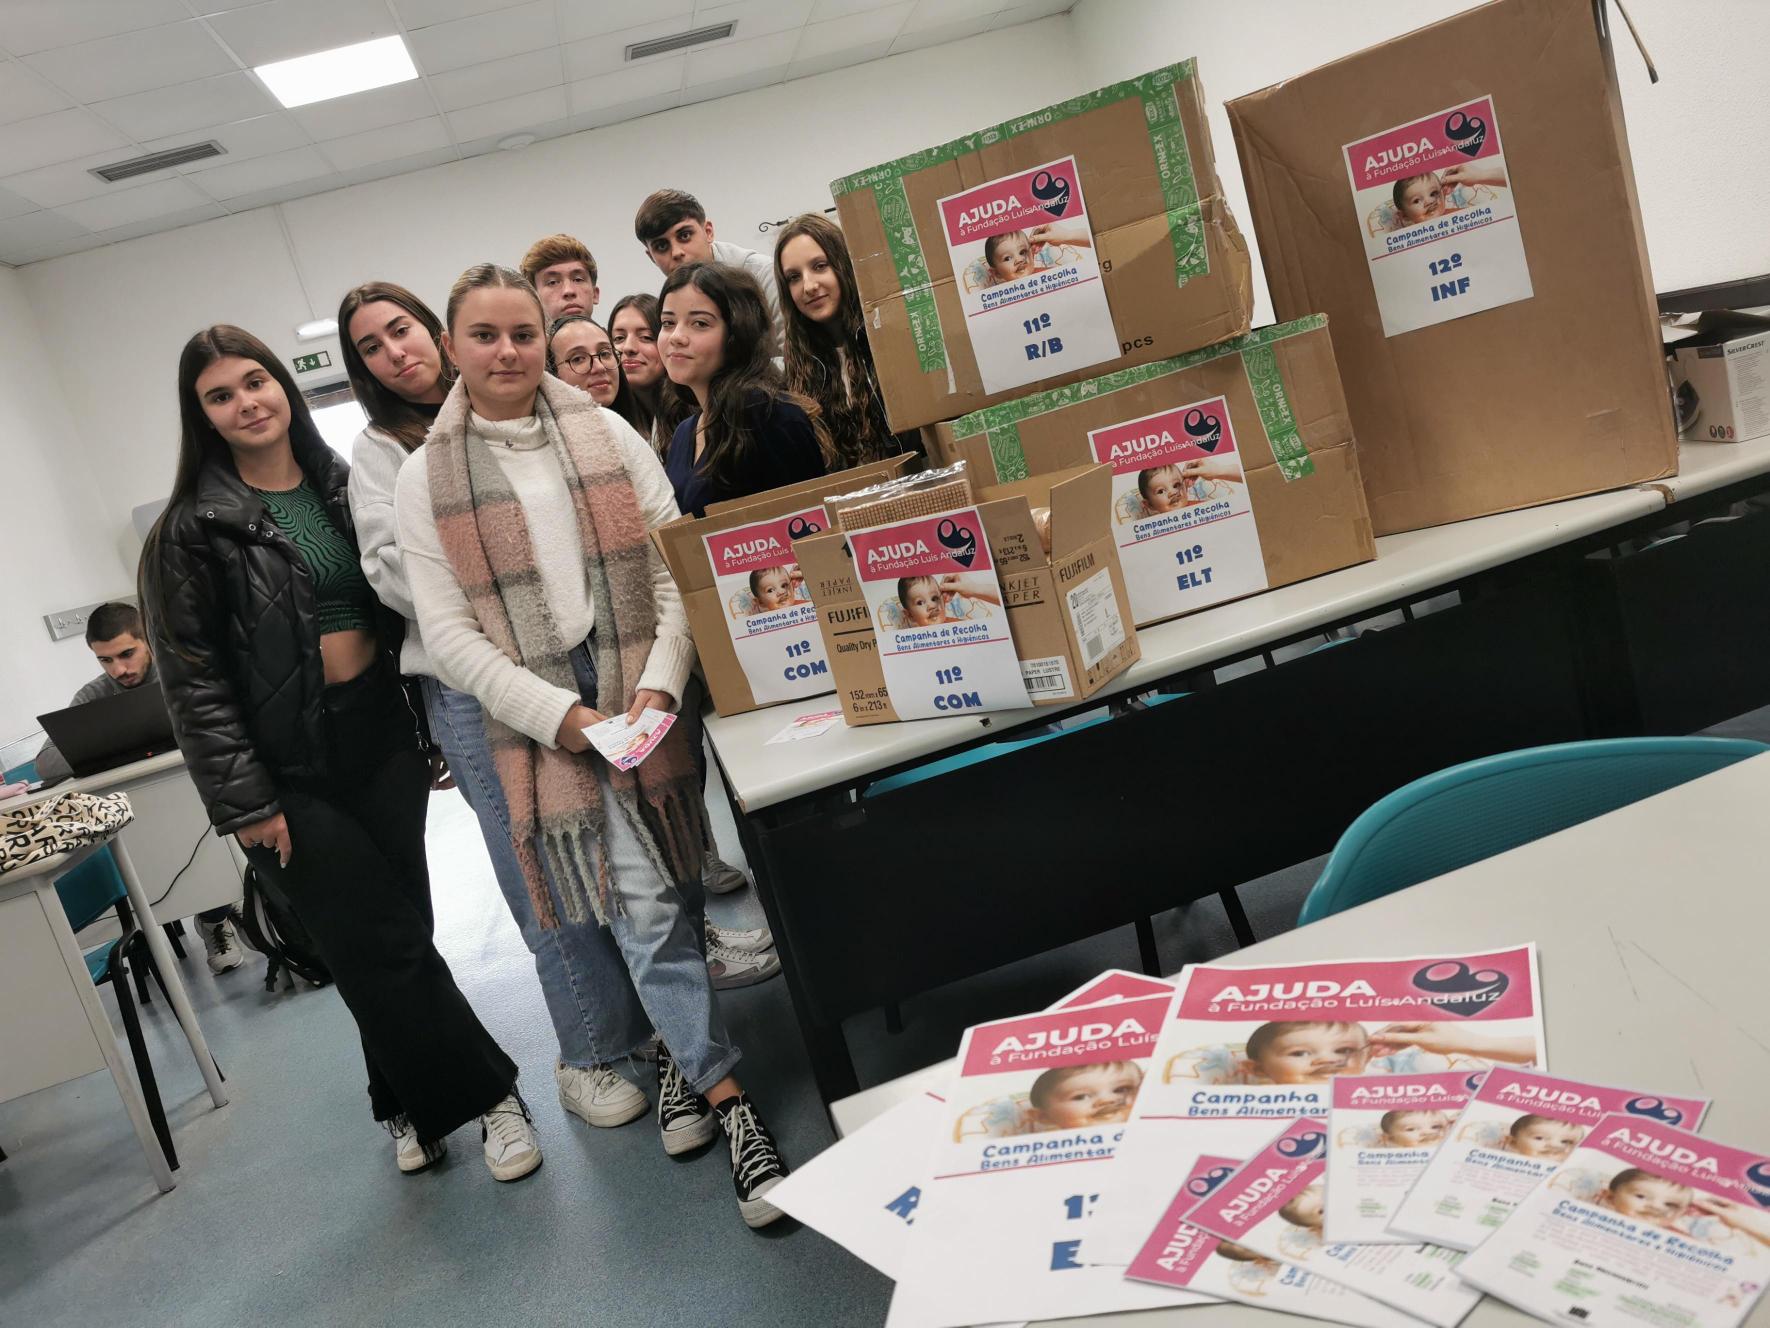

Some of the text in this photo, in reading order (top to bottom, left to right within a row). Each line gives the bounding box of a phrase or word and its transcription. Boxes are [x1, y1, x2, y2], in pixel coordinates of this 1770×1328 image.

[1364, 137, 1433, 172] AJUDA
[1374, 155, 1421, 178] Fundação
[958, 195, 1022, 228] AJUDA
[967, 215, 1010, 233] Fundação
[1386, 206, 1491, 246] Campanha de Recolha
[1388, 242, 1405, 253] Bens
[1406, 230, 1449, 247] Alimentares
[1429, 253, 1463, 276] 12º
[981, 266, 1078, 303] Campanha de Recolha
[1431, 277, 1470, 302] INF
[983, 301, 998, 310] Bens
[1000, 290, 1039, 306] Alimentares
[1023, 313, 1051, 335] 11º
[1025, 337, 1064, 360] R/B
[1122, 335, 1154, 355] pcs
[1110, 430, 1175, 459] AJUDA
[1119, 448, 1163, 466] Fundação
[1134, 500, 1230, 534] Campanha de Recolha
[1135, 531, 1151, 541] Bens
[723, 537, 780, 560] AJUDA
[731, 551, 772, 567] Fundação
[867, 539, 930, 564] AJUDA
[877, 557, 919, 572] Fundação
[940, 547, 976, 560] Andaluz
[1175, 544, 1203, 565] 11º
[1059, 552, 1095, 583] FUJIFILM
[1176, 567, 1212, 590] ELT
[1000, 576, 1039, 592] NKJET
[746, 613, 787, 628] Campanha
[789, 610, 799, 618] de
[828, 606, 871, 623] FUJIFI
[748, 626, 762, 635] Bens
[895, 624, 987, 643] Campanha de Recolha
[785, 640, 811, 658] 11º
[837, 642, 859, 653] Quality
[859, 640, 872, 651] Dry
[896, 644, 911, 652] Bens
[784, 659, 828, 681] COM
[935, 665, 963, 685] 11º
[850, 690, 865, 701] 152
[853, 702, 859, 713] 6
[868, 700, 882, 711] 213
[933, 691, 982, 710] COM
[1210, 979, 1377, 1002] AJUDA
[1207, 999, 1220, 1013] à
[1226, 996, 1338, 1013] Fundação
[992, 1018, 1146, 1056] AJUDA
[1007, 1038, 1112, 1063] Fundação
[1192, 1090, 1319, 1106] Campanha
[1351, 1084, 1447, 1099] AJUDA
[1361, 1096, 1427, 1105] Fundação
[1500, 1082, 1601, 1110] AJUDA
[1188, 1105, 1329, 1117] Bens Alimentar
[1507, 1094, 1576, 1114] Fundação
[982, 1131, 1104, 1158] Campanha
[1606, 1127, 1718, 1173] AJUDA
[980, 1147, 1116, 1171] Bens Alimentar
[1358, 1151, 1429, 1161] Campanha
[1469, 1149, 1541, 1170] Campanha
[1613, 1140, 1690, 1174] Fundação
[1218, 1168, 1289, 1223] AJUDA
[1557, 1199, 1735, 1266] Campanha de Recolha
